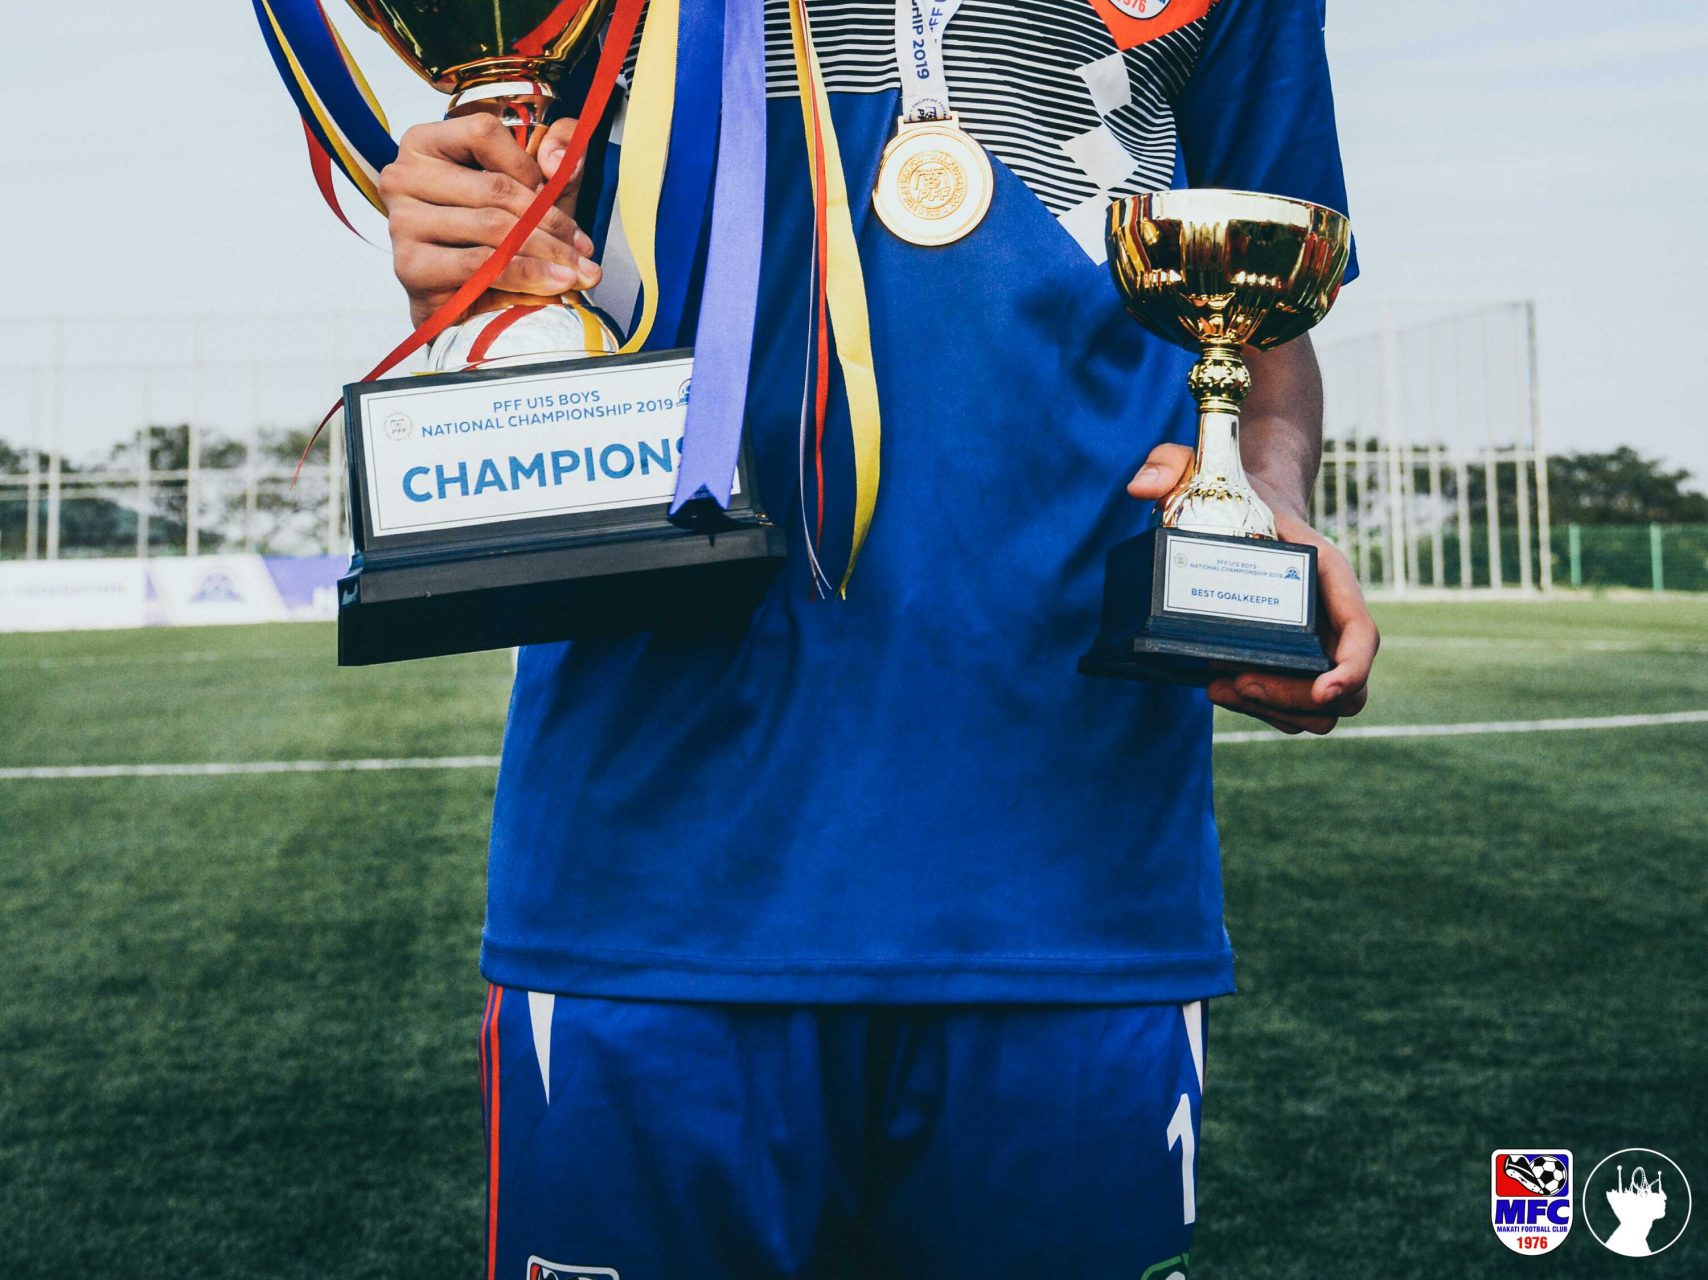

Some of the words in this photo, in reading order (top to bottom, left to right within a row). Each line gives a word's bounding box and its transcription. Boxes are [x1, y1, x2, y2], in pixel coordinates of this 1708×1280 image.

[912, 39, 930, 80] 2019
[493, 399, 522, 413] PFF
[527, 395, 554, 409] U15
[558, 390, 600, 406] BOYS
[421, 417, 504, 438] NATIONAL
[508, 403, 633, 428] CHAMPIONSHIP
[636, 398, 674, 413] 2019
[402, 436, 686, 503] CHAMPION
[1190, 563, 1220, 572] NATIONAL
[1221, 566, 1268, 577] CHAMPIONSHIP
[1191, 588, 1215, 598] BEST
[1217, 591, 1280, 605] GOALKEEPER
